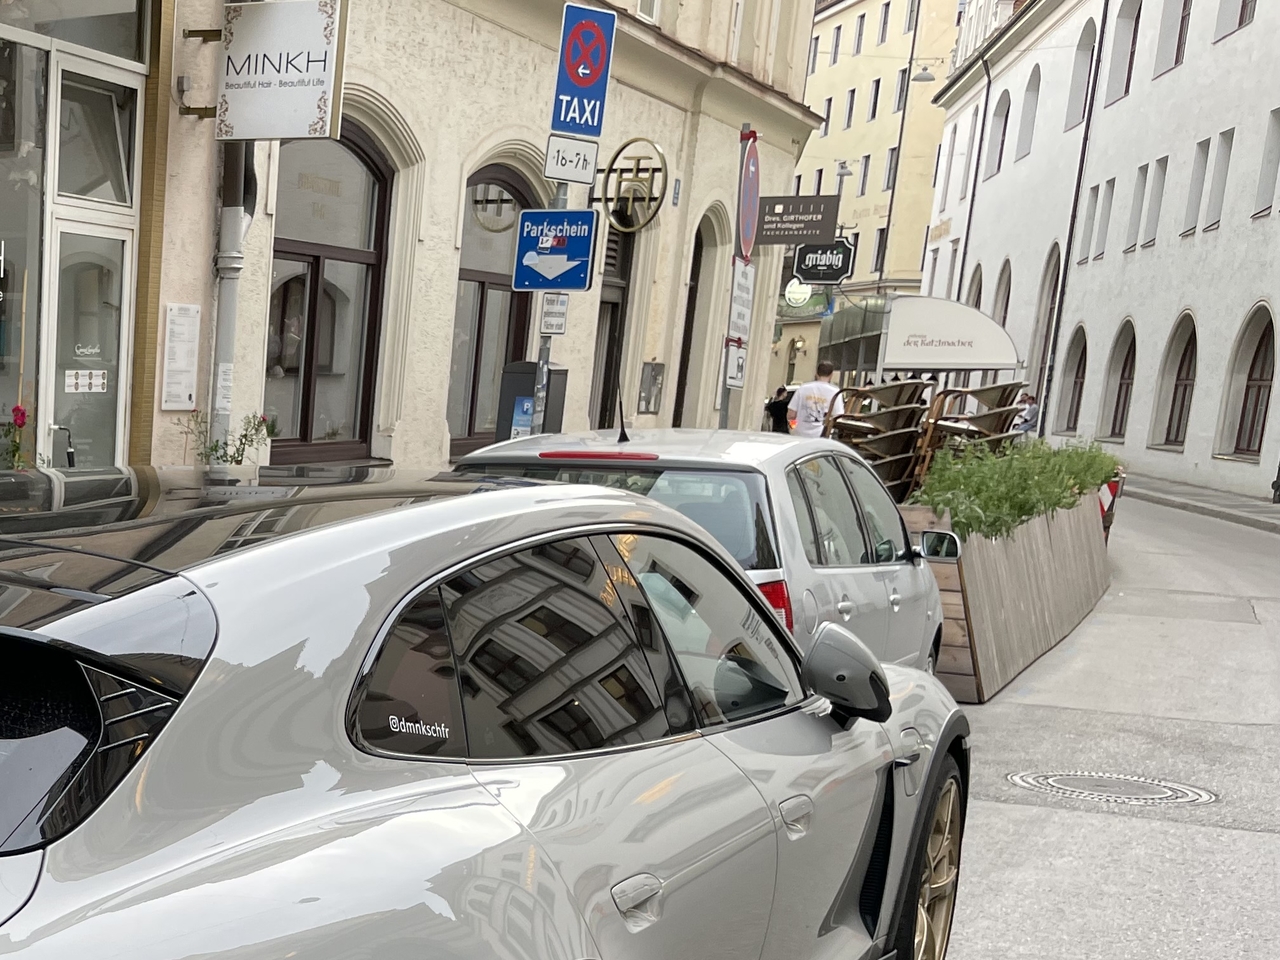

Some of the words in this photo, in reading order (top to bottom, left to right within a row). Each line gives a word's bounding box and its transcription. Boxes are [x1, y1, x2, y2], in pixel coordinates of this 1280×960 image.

[226, 50, 328, 76] MINKH
[224, 80, 257, 90] Beautiful
[257, 80, 273, 88] Hair
[278, 79, 311, 88] Beautiful
[312, 78, 325, 87] Life
[558, 94, 601, 127] TAXI
[523, 221, 589, 237] Parkschein
[389, 715, 449, 739] @dmnkschfr
